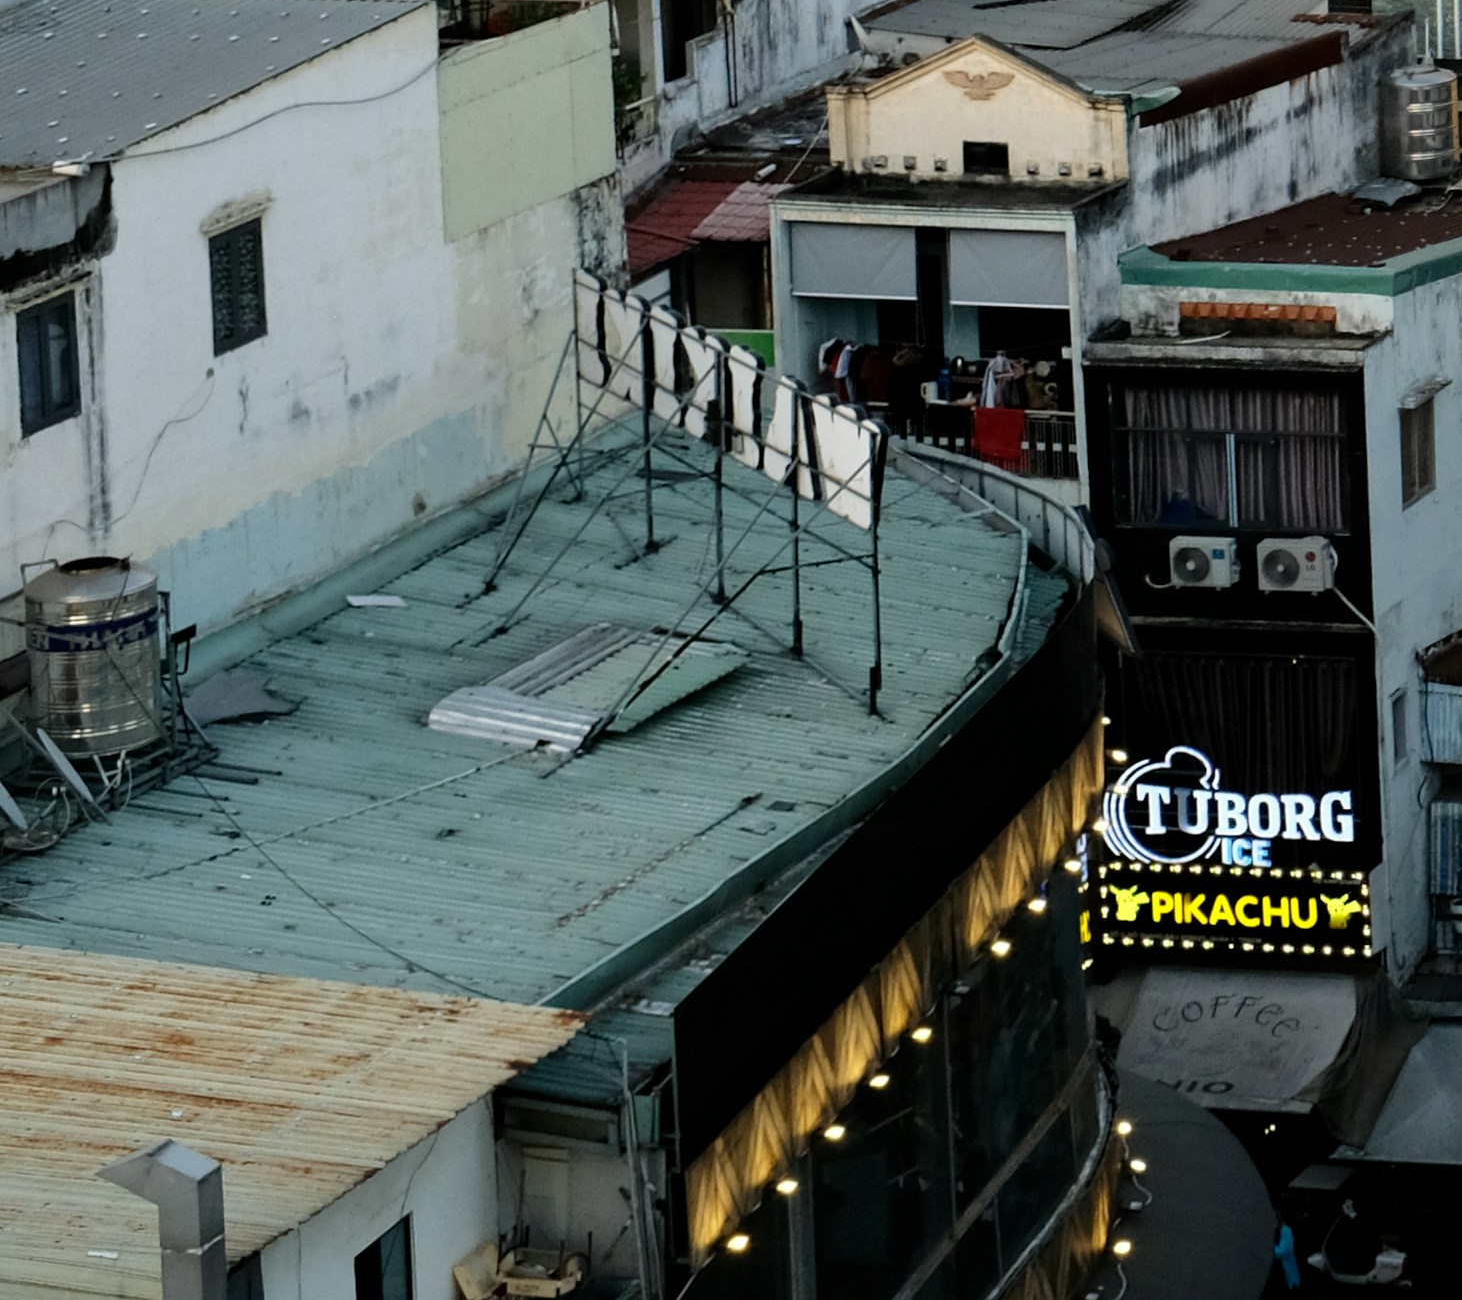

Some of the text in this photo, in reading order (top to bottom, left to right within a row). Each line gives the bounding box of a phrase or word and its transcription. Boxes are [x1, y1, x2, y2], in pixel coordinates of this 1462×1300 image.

[1136, 782, 1355, 843] TUBORG
[1220, 837, 1272, 868] ICE
[1151, 890, 1319, 930] PIKACHU
